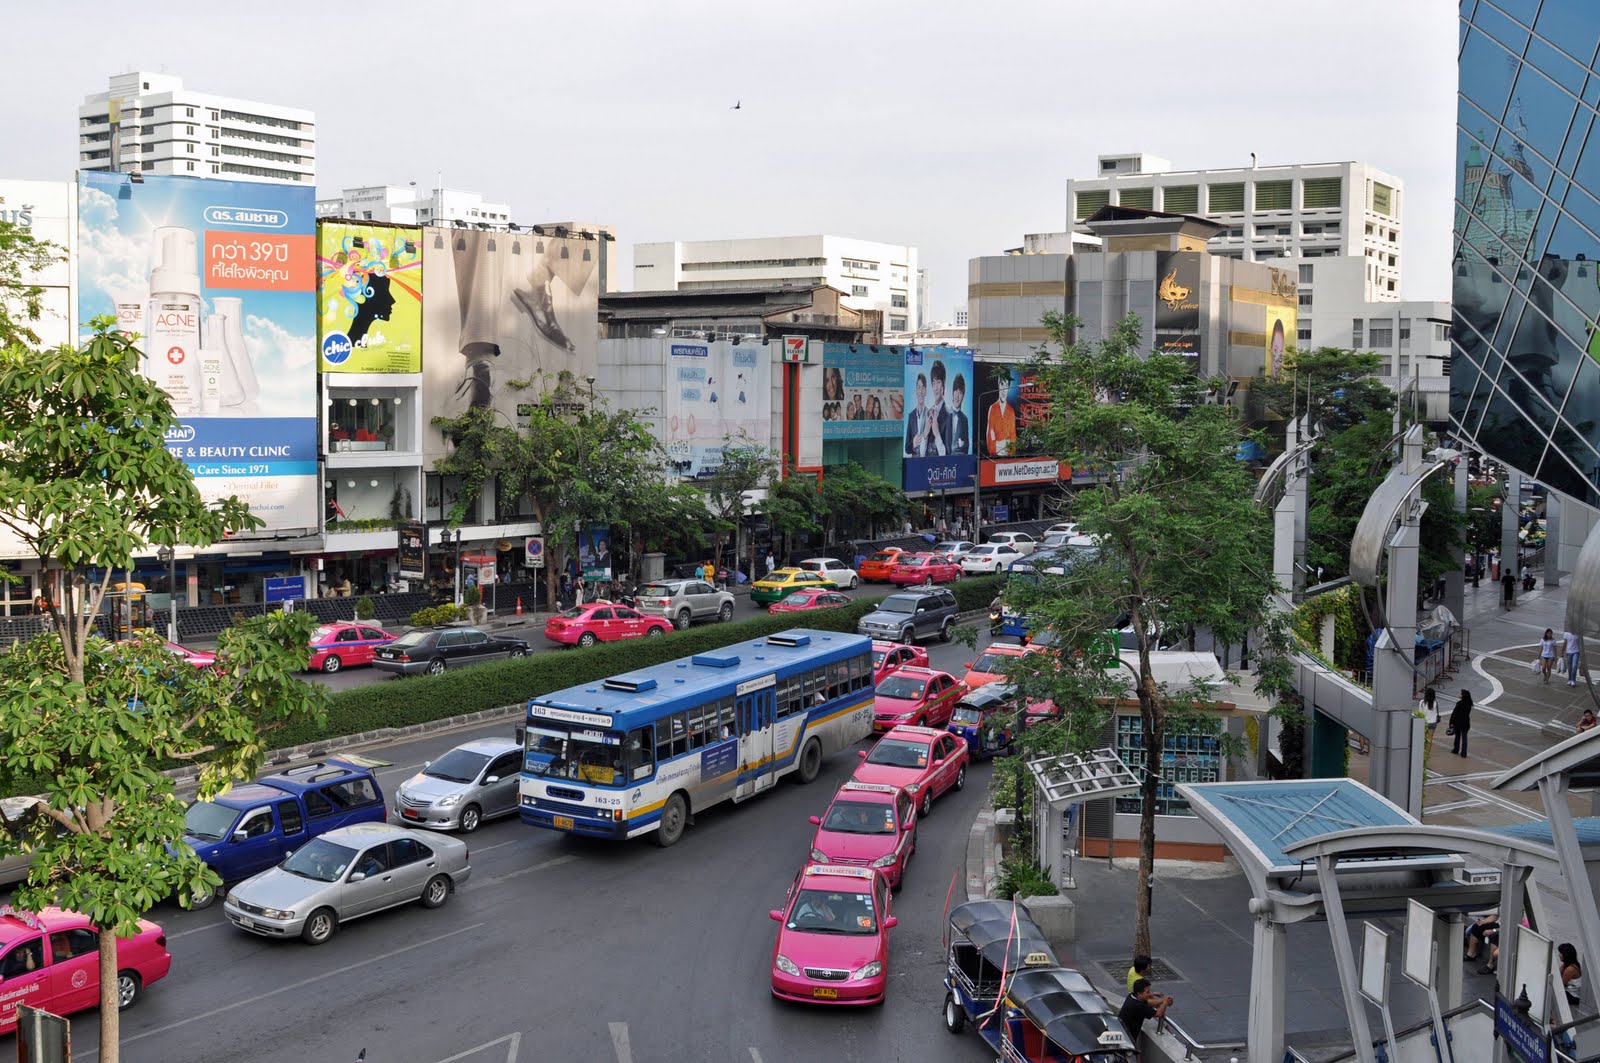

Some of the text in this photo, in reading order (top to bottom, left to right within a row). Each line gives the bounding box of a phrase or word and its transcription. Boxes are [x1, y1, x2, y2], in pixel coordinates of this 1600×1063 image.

[212, 240, 288, 262] กว่า 39 ปี
[117, 311, 142, 320] ACNE
[156, 314, 195, 327] ACNE
[325, 341, 351, 355] chic
[186, 447, 196, 457] &
[200, 447, 246, 457] BEAUTY
[249, 446, 291, 456] CLINIC
[197, 465, 219, 474] Care
[221, 465, 247, 474] Since
[249, 465, 269, 473] 1971
[998, 463, 1057, 477] www.NetDesign.ac.th
[534, 707, 547, 715] 163
[595, 796, 621, 805] 163-25
[1472, 874, 1498, 883] BTS
[1029, 954, 1047, 962] TAXI
